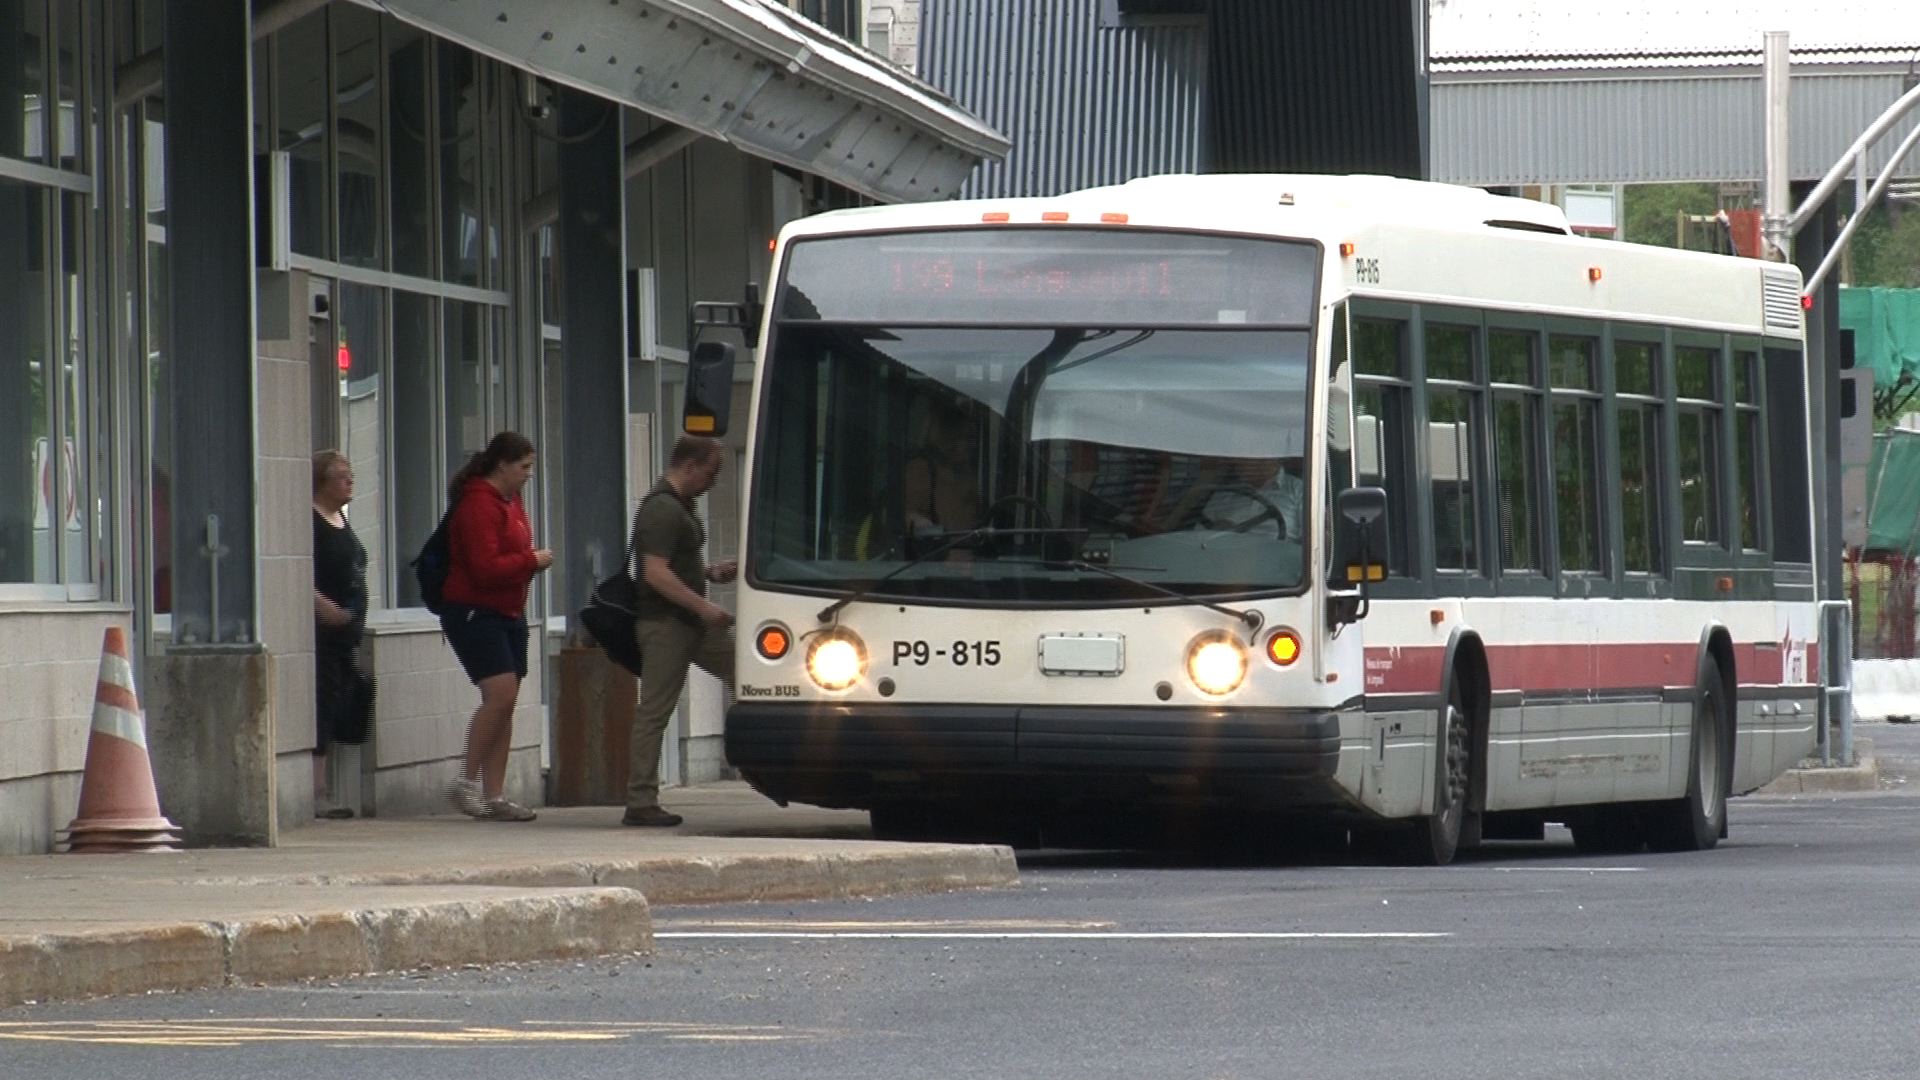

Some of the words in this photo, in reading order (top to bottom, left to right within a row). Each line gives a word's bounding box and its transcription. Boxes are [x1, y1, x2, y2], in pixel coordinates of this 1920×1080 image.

[976, 258, 1171, 295] Lnguil
[892, 640, 1001, 667] P9-815
[741, 684, 772, 697] Nova
[774, 684, 801, 697] BUS
